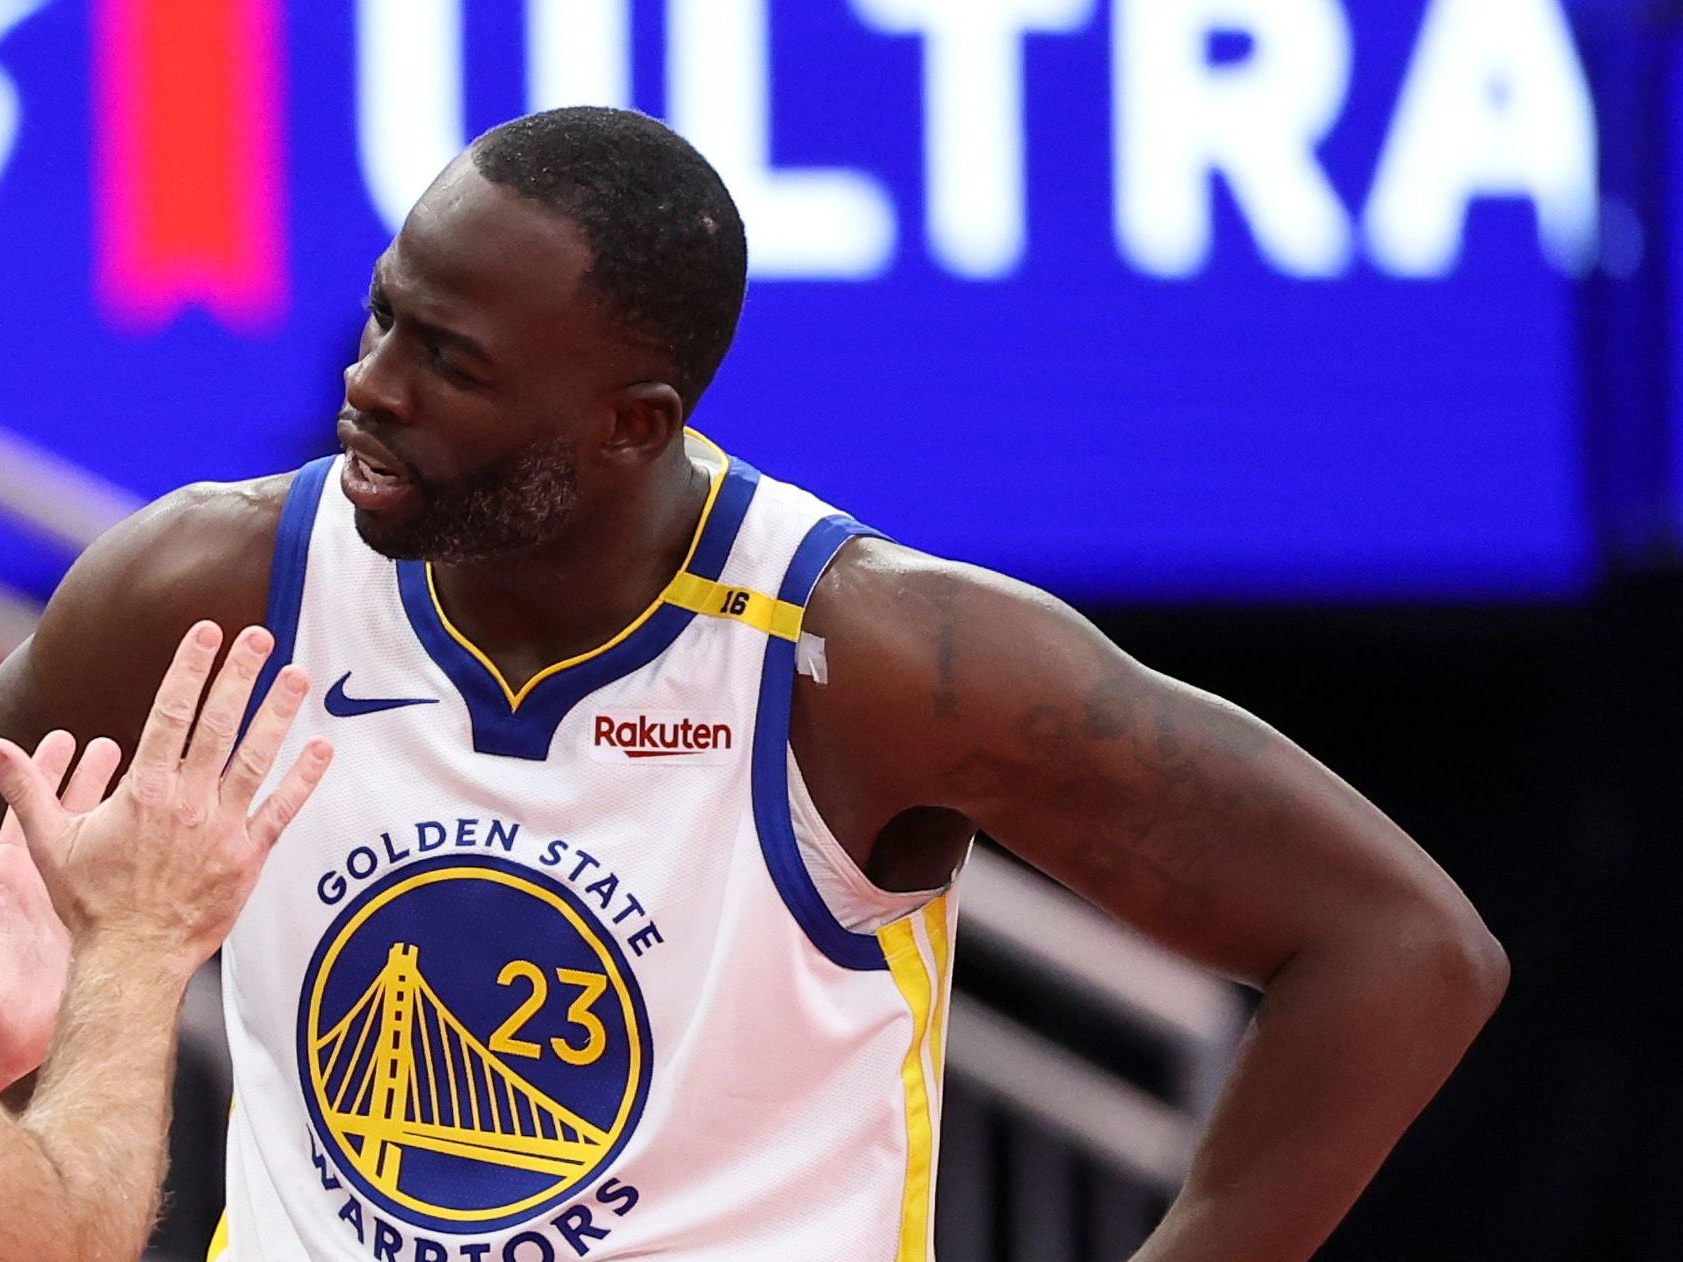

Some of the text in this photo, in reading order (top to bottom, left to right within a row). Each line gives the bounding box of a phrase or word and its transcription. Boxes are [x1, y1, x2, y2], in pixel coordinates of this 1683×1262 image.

[720, 590, 749, 616] 16
[594, 715, 732, 750] Rakuten
[316, 818, 664, 957] GOLDEN STATE
[488, 960, 608, 1066] 23
